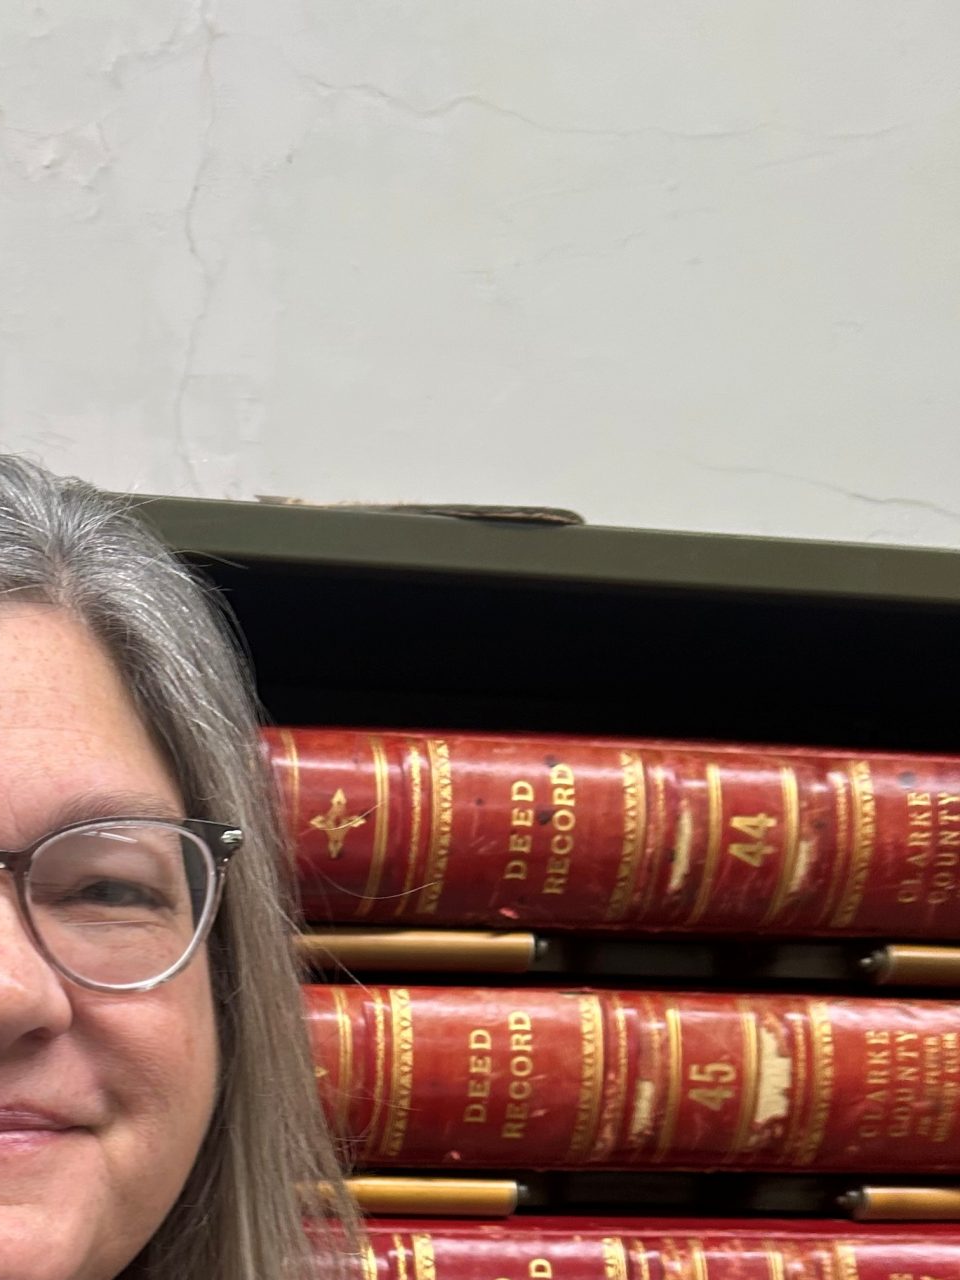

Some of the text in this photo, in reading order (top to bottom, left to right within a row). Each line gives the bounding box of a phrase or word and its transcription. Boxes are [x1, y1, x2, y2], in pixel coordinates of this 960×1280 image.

[504, 780, 535, 880] DEED
[543, 763, 576, 895] RECORD
[728, 812, 778, 868] 44
[898, 792, 933, 903] CLARKE
[463, 1027, 492, 1124] DEED
[502, 1010, 532, 1139] RECORD
[688, 1062, 737, 1110] 45
